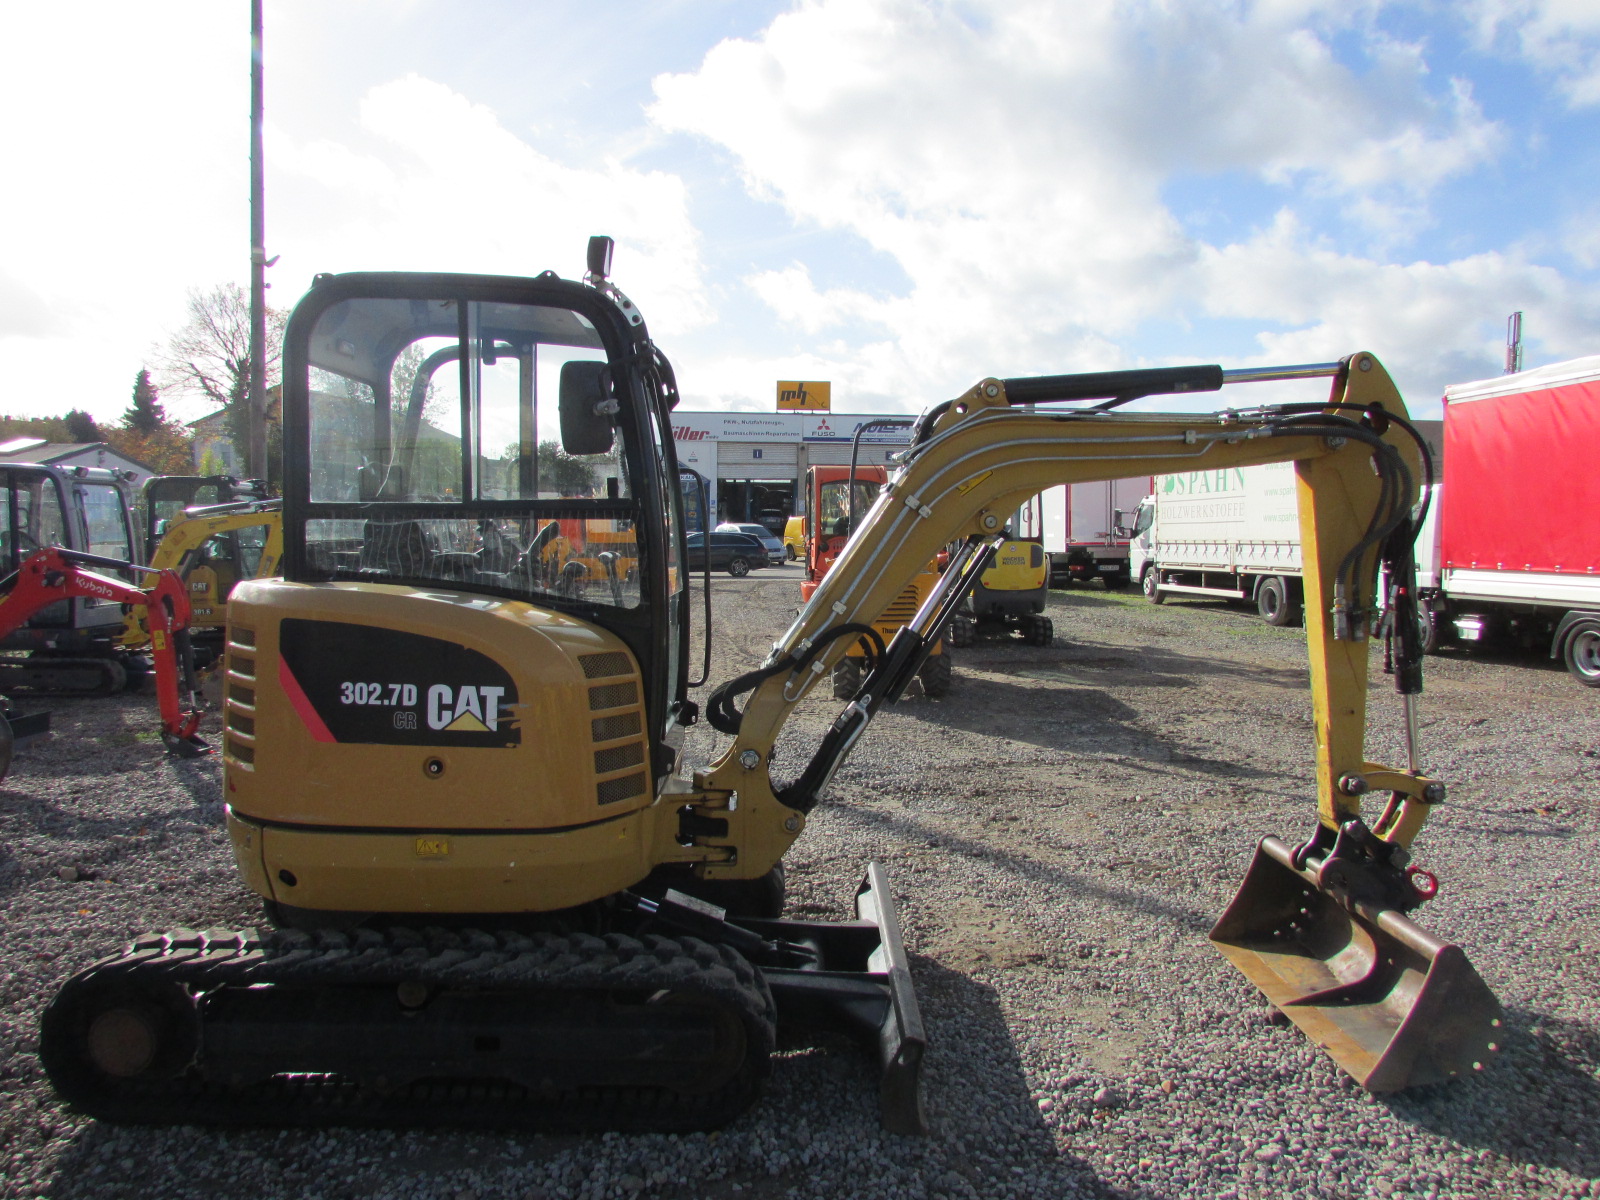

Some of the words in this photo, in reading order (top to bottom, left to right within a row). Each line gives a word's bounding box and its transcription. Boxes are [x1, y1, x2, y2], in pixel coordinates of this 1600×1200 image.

[1176, 467, 1246, 495] SPAHN
[1161, 502, 1245, 520] HOLZWERKSTOFFE
[76, 576, 113, 597] Kubota
[192, 582, 207, 592] CAT
[340, 681, 418, 706] 302.7D
[427, 683, 505, 732] CAT
[393, 711, 417, 730] CR
